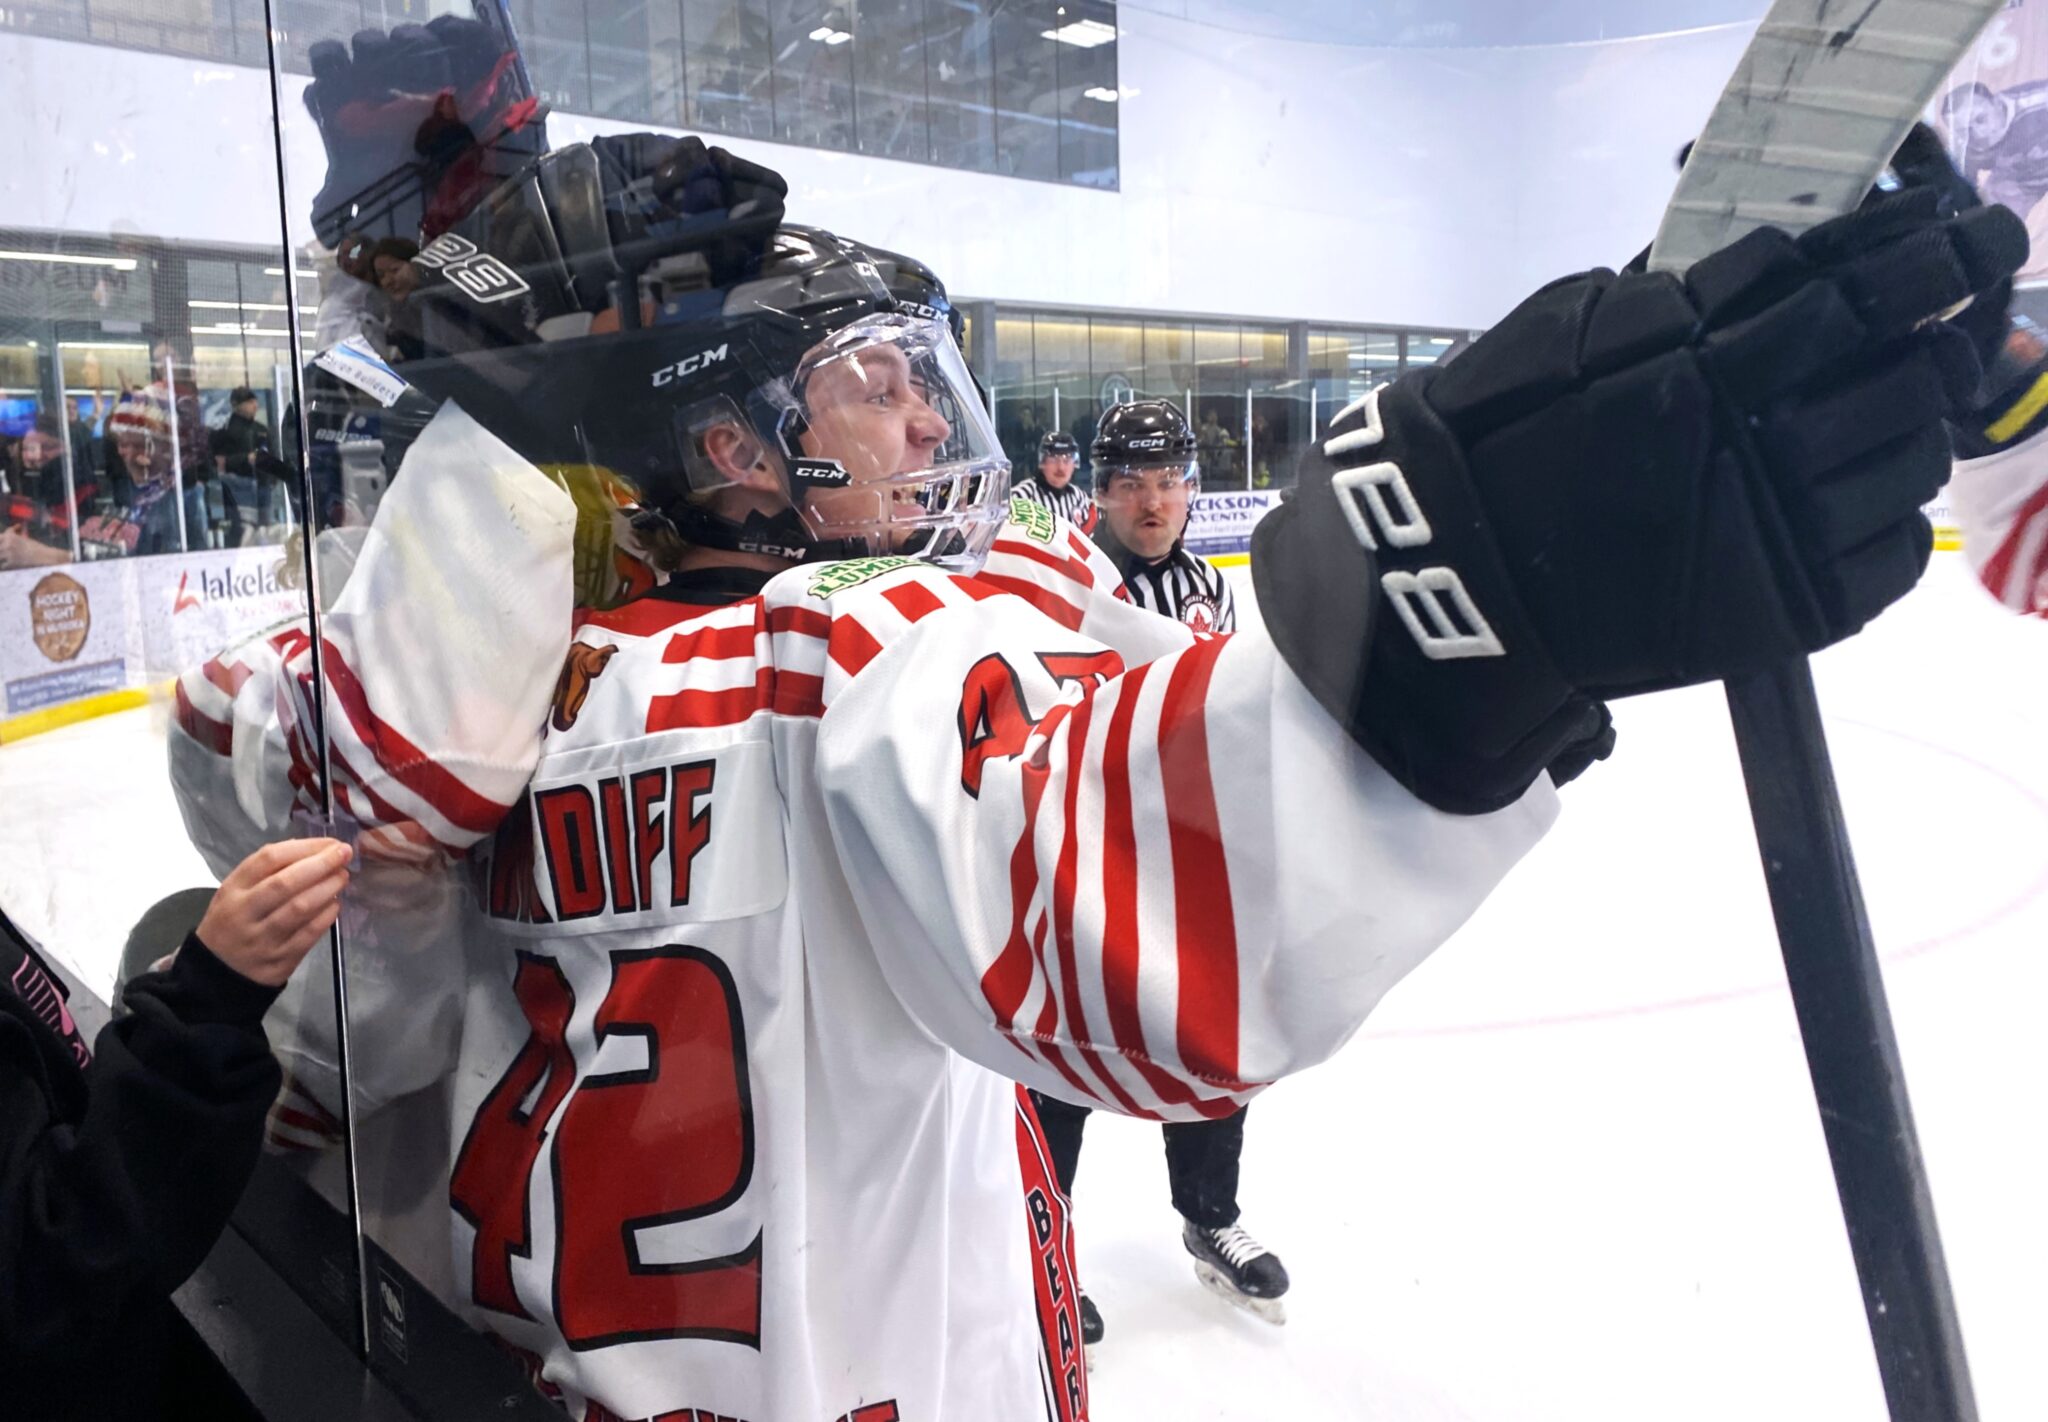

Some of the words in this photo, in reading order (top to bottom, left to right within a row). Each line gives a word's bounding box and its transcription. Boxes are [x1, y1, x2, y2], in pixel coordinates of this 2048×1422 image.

[651, 343, 728, 387] CCM
[1128, 438, 1166, 448] CCM
[796, 467, 845, 480] CCM
[738, 542, 807, 560] CCM
[449, 942, 763, 1352] 42
[1027, 1186, 1084, 1422] BEAR
